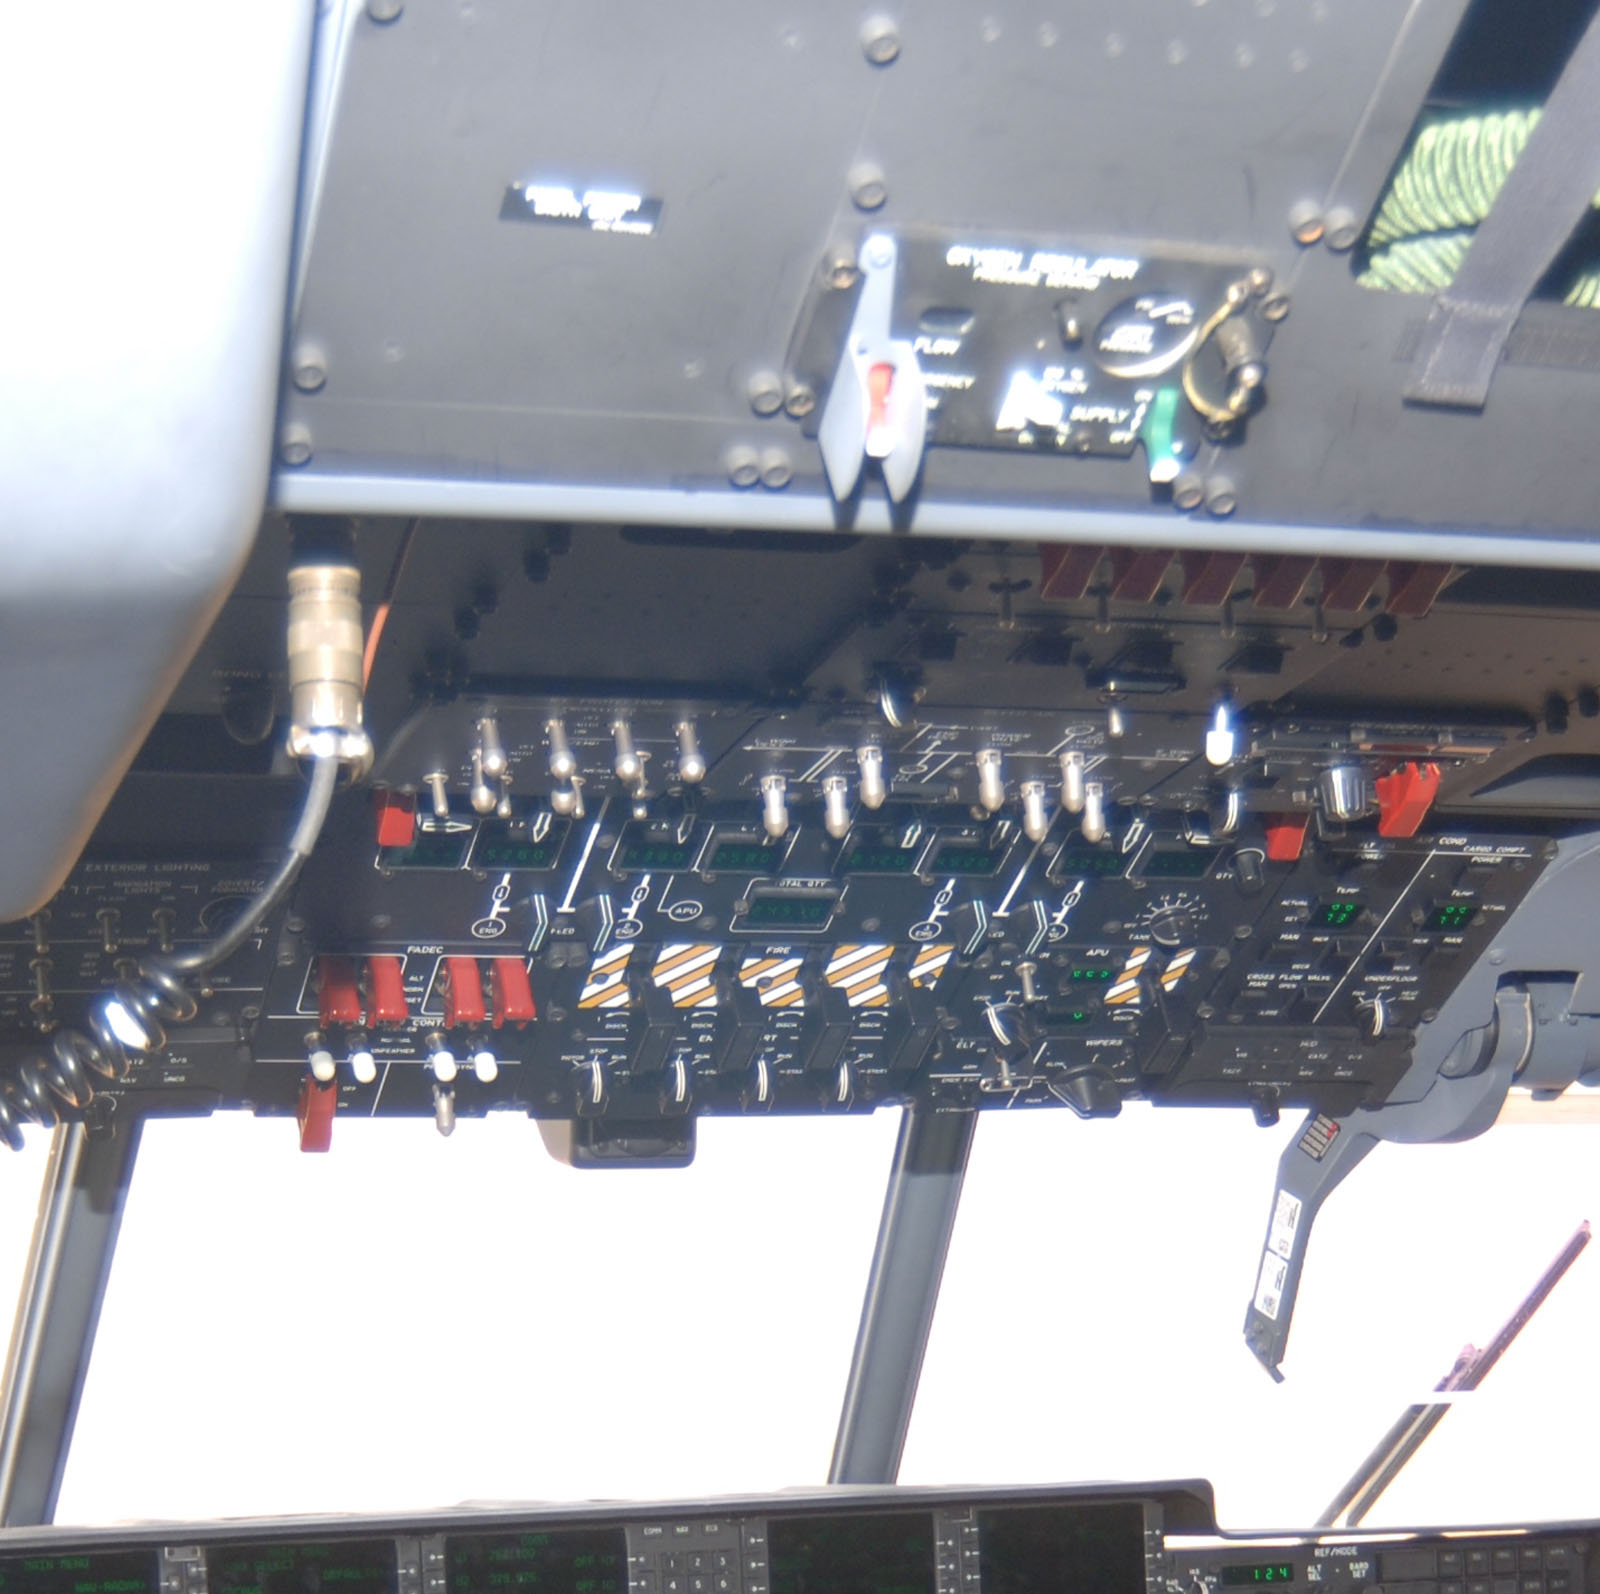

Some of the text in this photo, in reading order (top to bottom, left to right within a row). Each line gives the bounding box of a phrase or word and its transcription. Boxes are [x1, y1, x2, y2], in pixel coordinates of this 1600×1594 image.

[1439, 838, 1467, 846] COND
[675, 907, 698, 915] APU
[407, 946, 443, 954] FADEC
[766, 946, 791, 955] FIRE
[1086, 949, 1109, 957] APU
[1314, 1547, 1358, 1557] REF/MODE
[1254, 1568, 1287, 1581] 124
